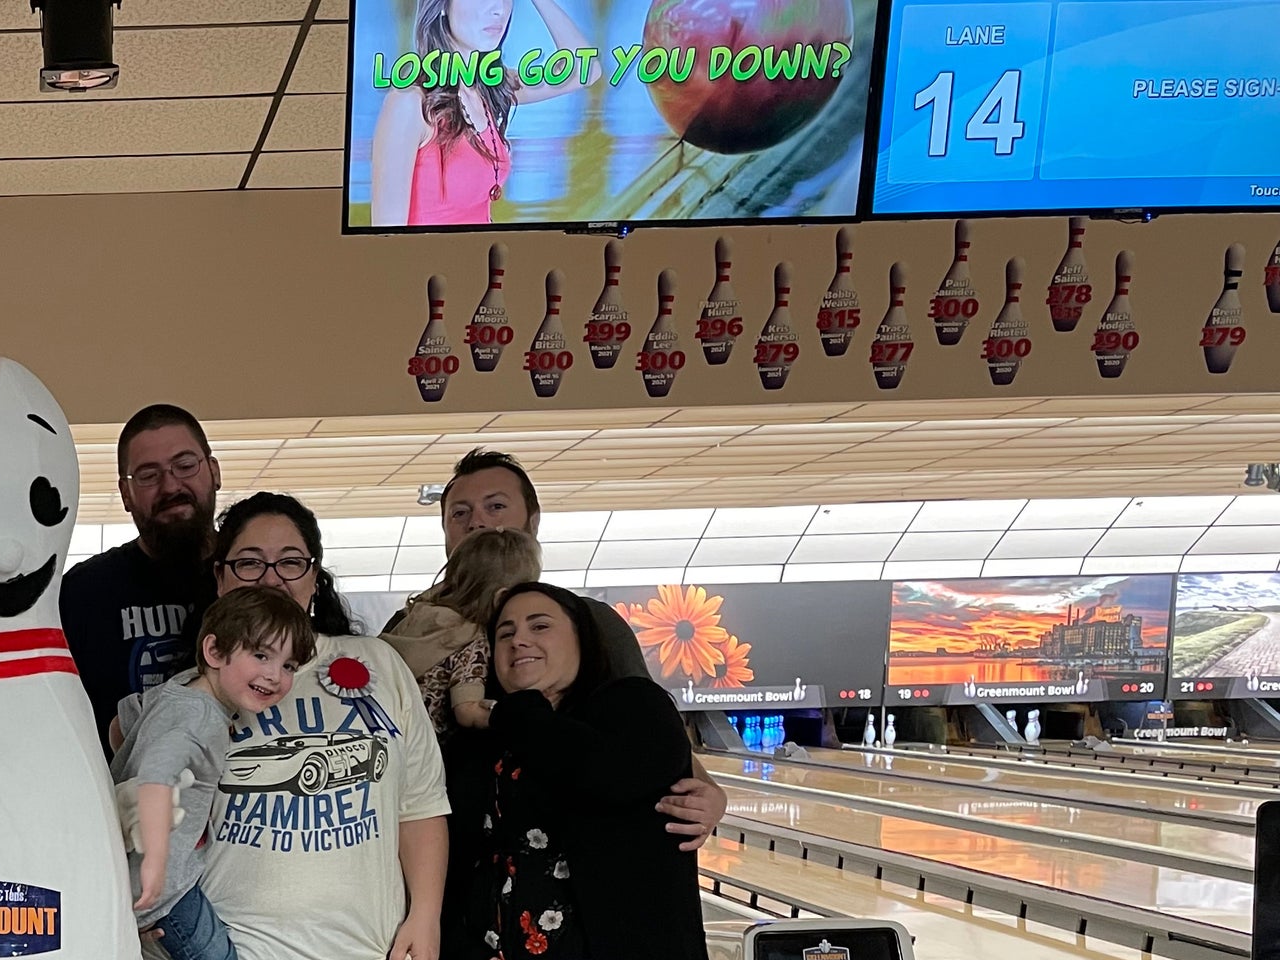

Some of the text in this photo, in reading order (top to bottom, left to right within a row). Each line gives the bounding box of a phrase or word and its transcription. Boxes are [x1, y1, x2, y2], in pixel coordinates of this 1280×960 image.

[945, 26, 1006, 45] LANE
[373, 41, 852, 89] LOSING GOT YOU DOWN?
[1132, 78, 1218, 98] PLEASE
[914, 70, 1024, 157] 14
[1249, 184, 1280, 196] Touc
[1062, 265, 1082, 274] Jeff
[945, 280, 969, 288] Paul
[1054, 275, 1088, 283] Sainer
[824, 291, 857, 299] Bobby
[600, 304, 619, 312] Jim
[821, 299, 859, 308] Weaver
[928, 299, 979, 318] 300
[479, 306, 504, 315] Dave
[708, 308, 735, 316] Hurd
[1212, 308, 1241, 316] Brent
[474, 315, 508, 323] Moore
[816, 309, 860, 330] 815
[1106, 313, 1130, 321] Nick
[1212, 317, 1239, 325] Hahn
[695, 318, 743, 339] 296
[768, 325, 790, 333] Kris
[881, 325, 909, 333] Tracy
[1098, 322, 1135, 330] Hodges
[464, 325, 514, 345] 300
[538, 332, 562, 341] Jack
[583, 322, 631, 342] 299
[648, 333, 678, 341] Eddie
[1199, 327, 1246, 347] 279
[425, 337, 445, 346] Jeff
[535, 340, 565, 349] Bitzel
[1091, 331, 1139, 351] 290
[418, 346, 451, 354] Sainer
[753, 343, 799, 363] 279
[869, 342, 914, 363] 277
[980, 338, 1032, 359] 300
[407, 356, 459, 376] 800
[523, 351, 573, 371] 300
[635, 351, 685, 371] 300
[121, 604, 187, 640] HUD
[977, 684, 1075, 698] Greenmount Bowl
[1140, 682, 1154, 693] 20
[1181, 682, 1194, 692] 21
[695, 690, 793, 704] Greenmount Bowl
[857, 689, 871, 699] 18
[898, 689, 911, 699] 19
[229, 697, 363, 742] CRUZ
[1201, 727, 1227, 737] Bowl
[325, 743, 366, 757] DINOCO
[225, 781, 376, 831] RAMIREZ
[216, 815, 380, 852] CRUZ TO VICTORY!
